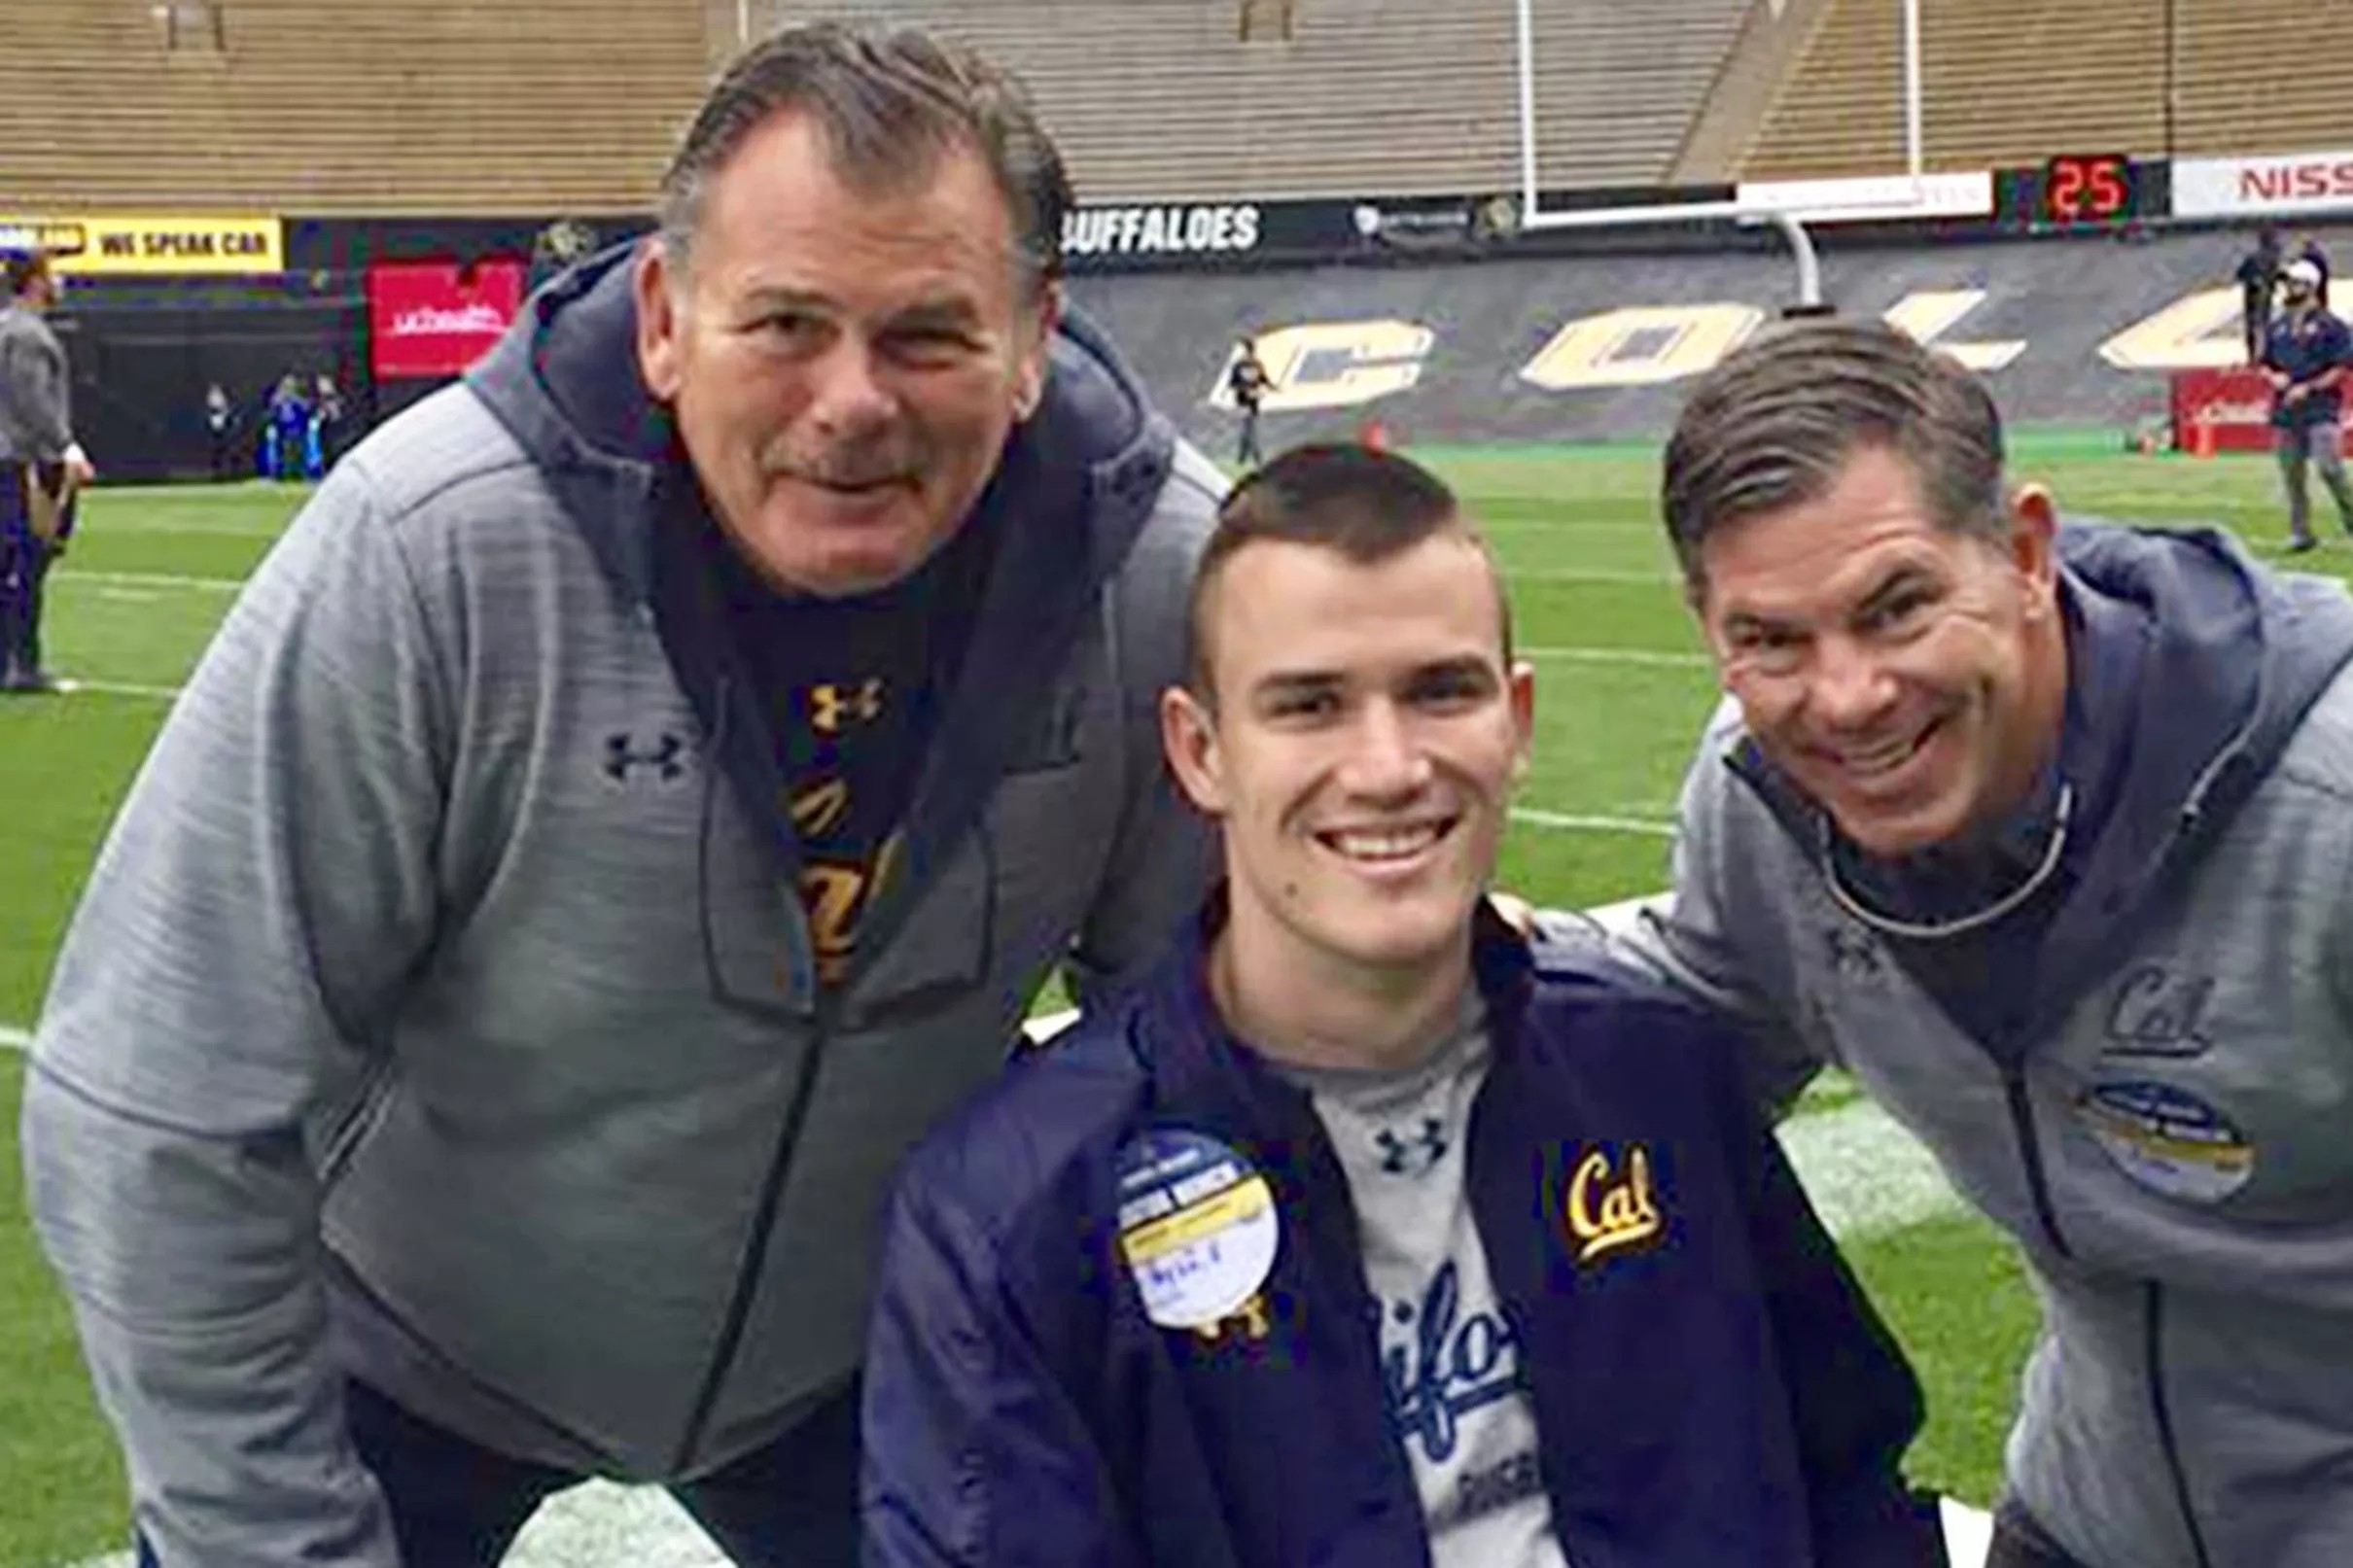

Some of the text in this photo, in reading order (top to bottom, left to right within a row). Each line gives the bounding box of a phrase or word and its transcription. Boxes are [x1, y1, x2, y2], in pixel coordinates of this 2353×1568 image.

[2053, 161, 2123, 215] 25
[100, 233, 134, 257] WE
[143, 233, 215, 257] SPEAK
[1567, 1148, 1660, 1259] Cal
